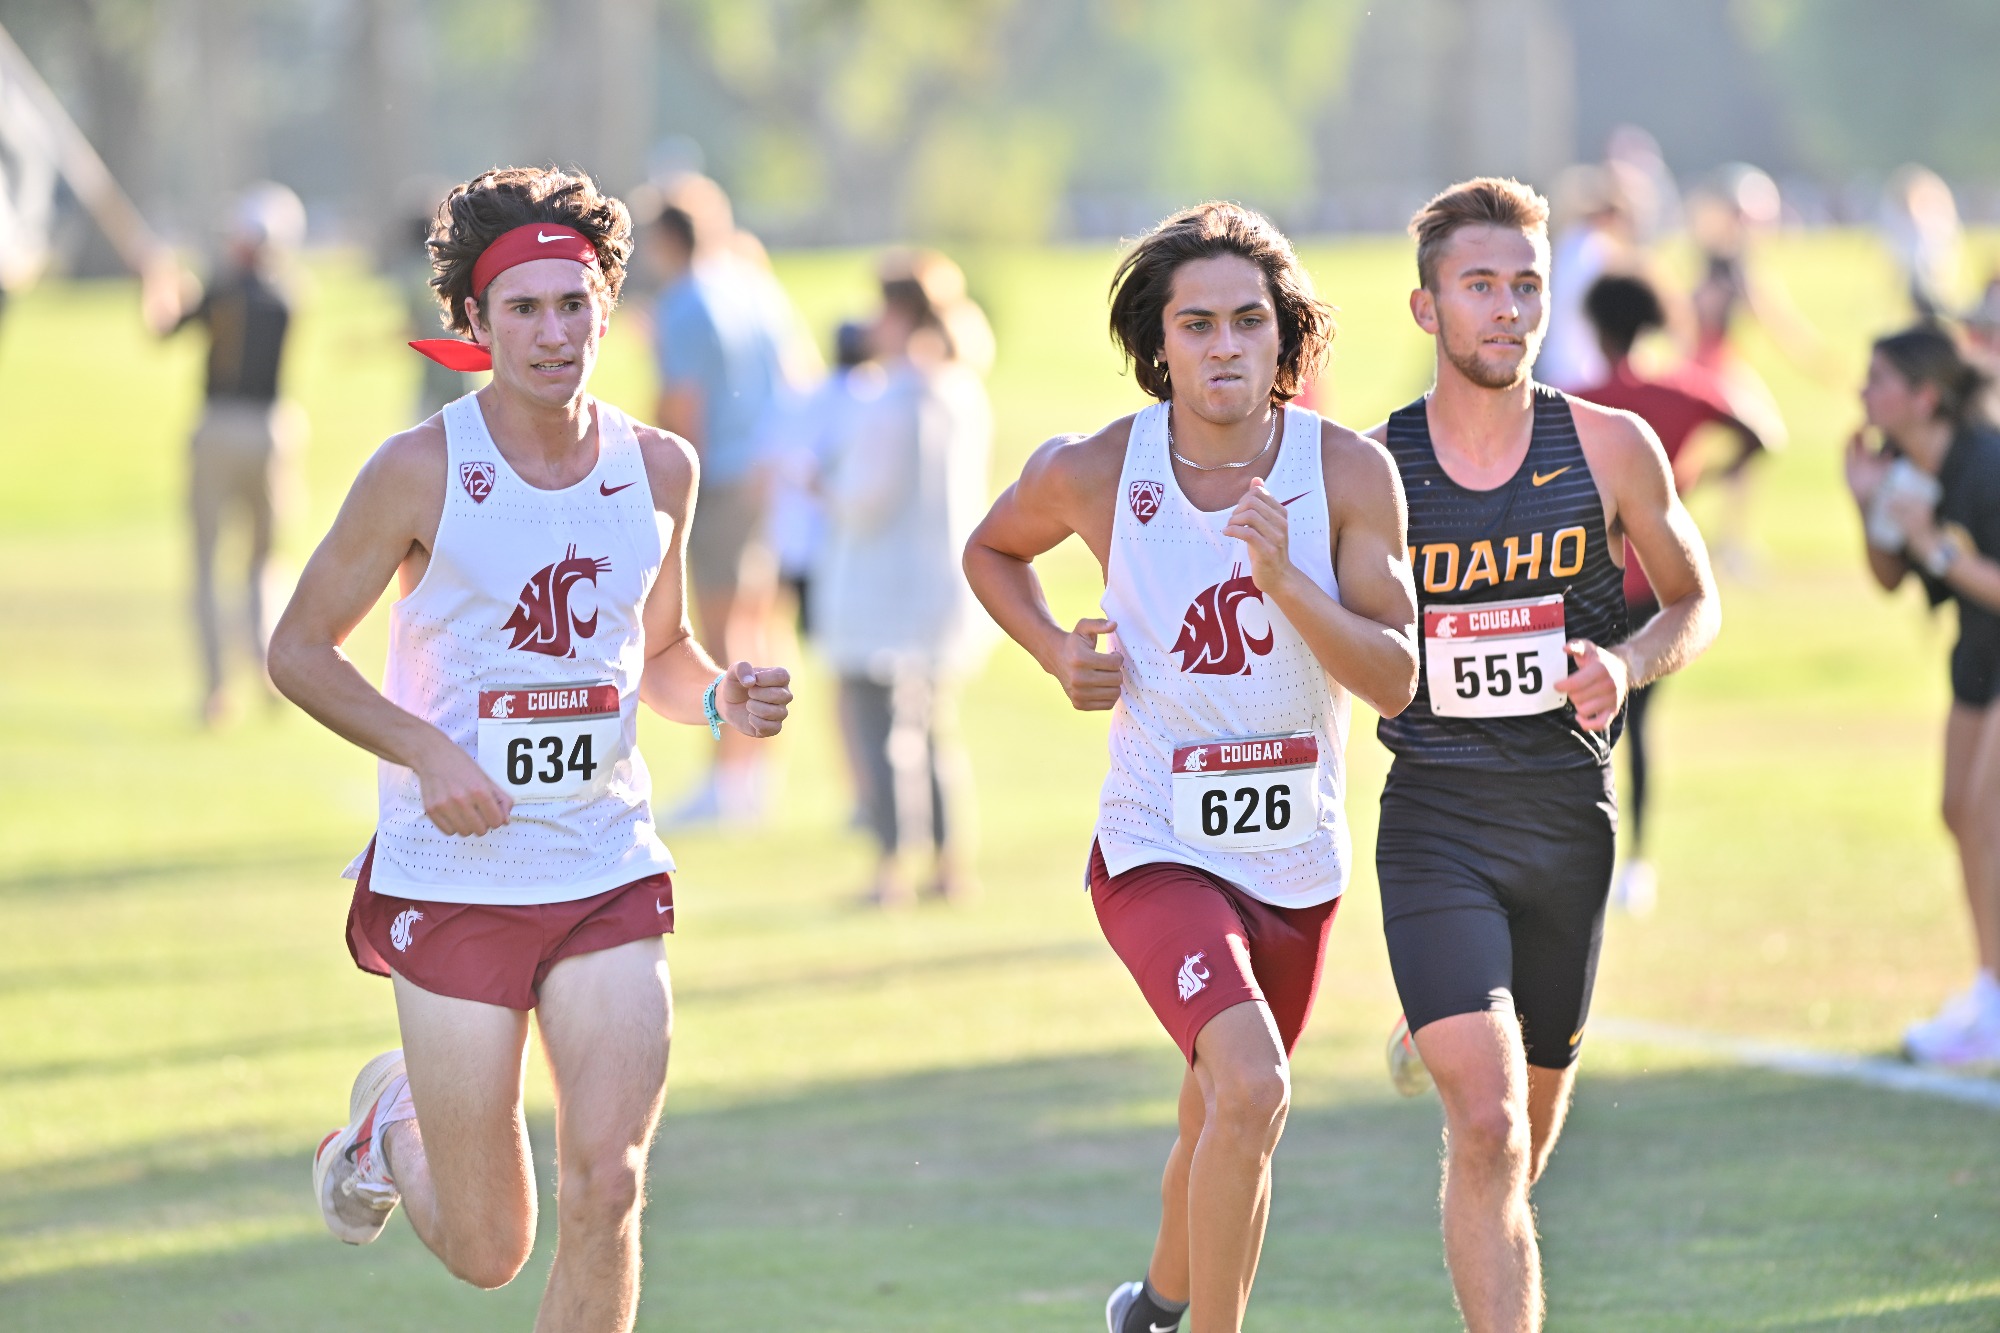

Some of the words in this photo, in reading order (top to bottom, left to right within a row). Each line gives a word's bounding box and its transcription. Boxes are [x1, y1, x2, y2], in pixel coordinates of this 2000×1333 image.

[460, 462, 494, 488] PAC
[470, 479, 488, 496] 12
[1130, 481, 1163, 508] PAC
[1136, 499, 1154, 516] 12
[1408, 525, 1586, 593] DAHO
[1469, 607, 1531, 631] COUGAR
[1453, 651, 1543, 699] 555
[528, 689, 589, 711] COUGAR
[507, 734, 597, 785] 634
[1220, 741, 1283, 763] COUGAR
[1201, 784, 1291, 836] 626
